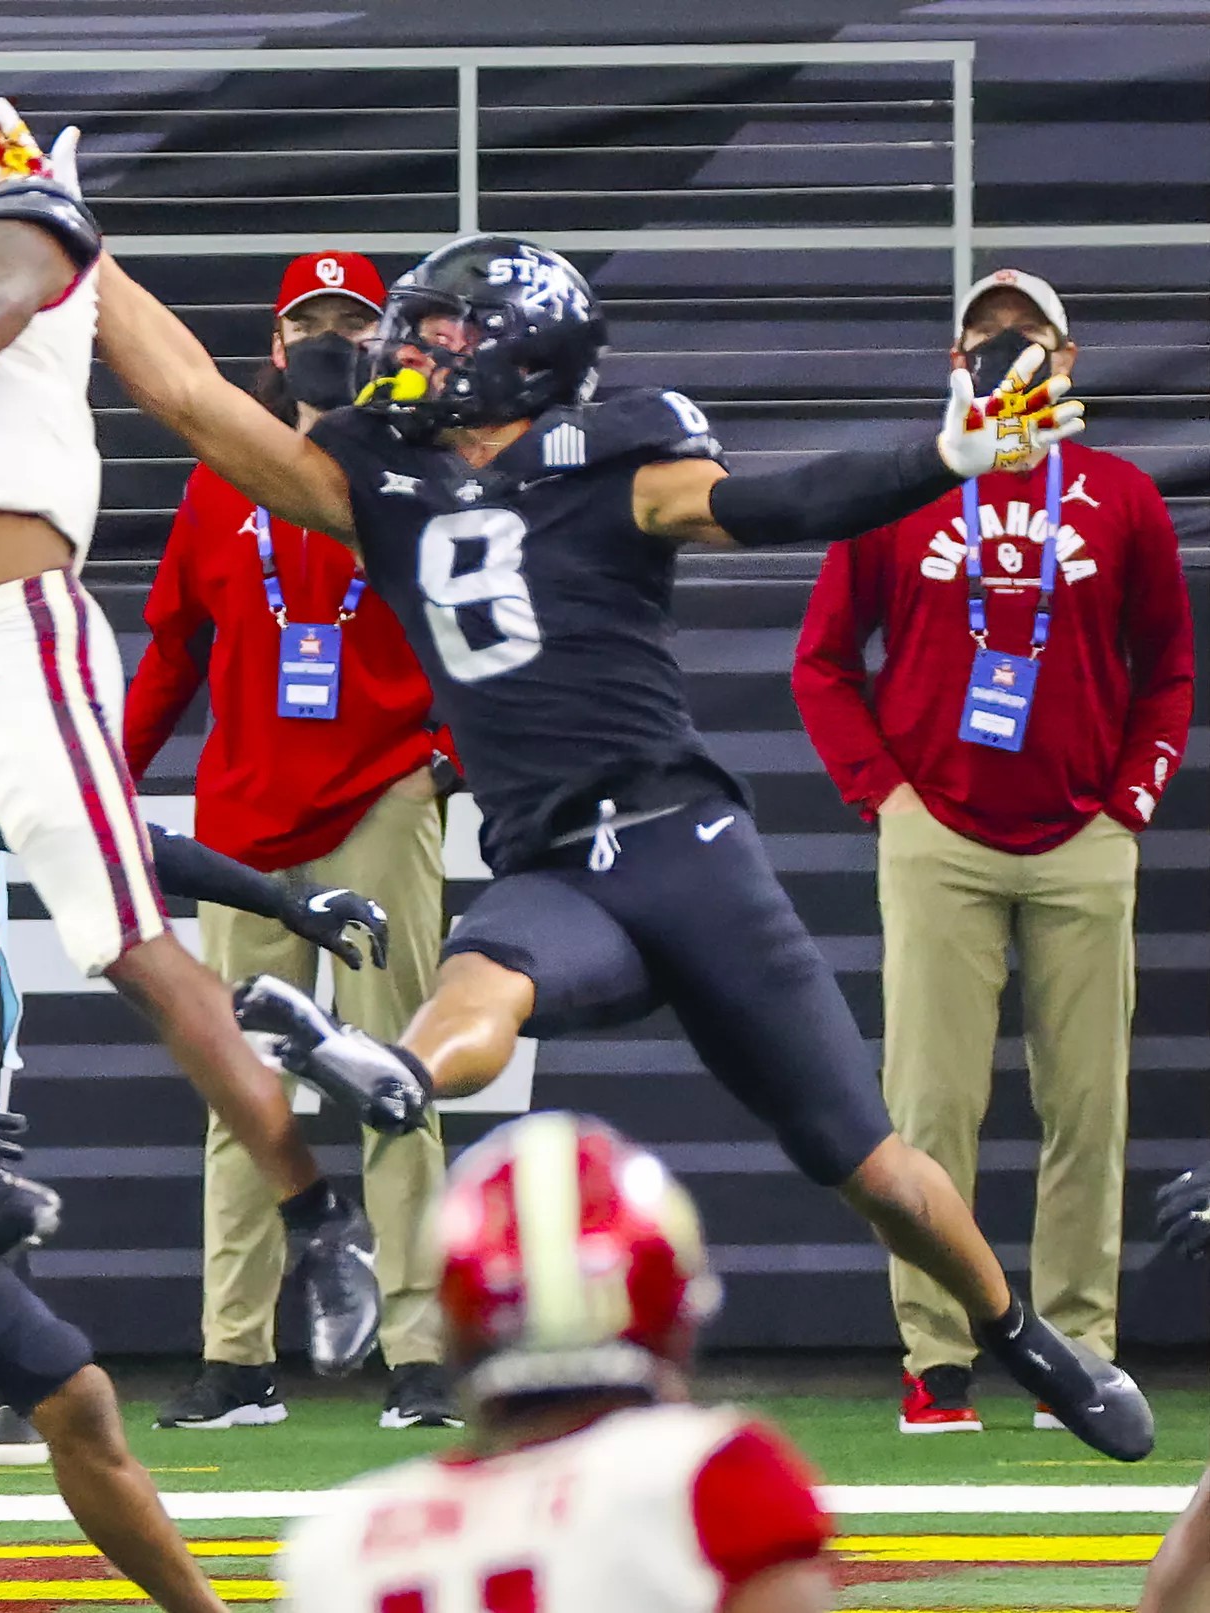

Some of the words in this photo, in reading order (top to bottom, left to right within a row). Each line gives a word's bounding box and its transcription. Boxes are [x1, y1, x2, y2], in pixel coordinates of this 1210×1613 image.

[316, 257, 345, 287] OU
[661, 390, 710, 435] 8
[417, 507, 542, 683] 8
